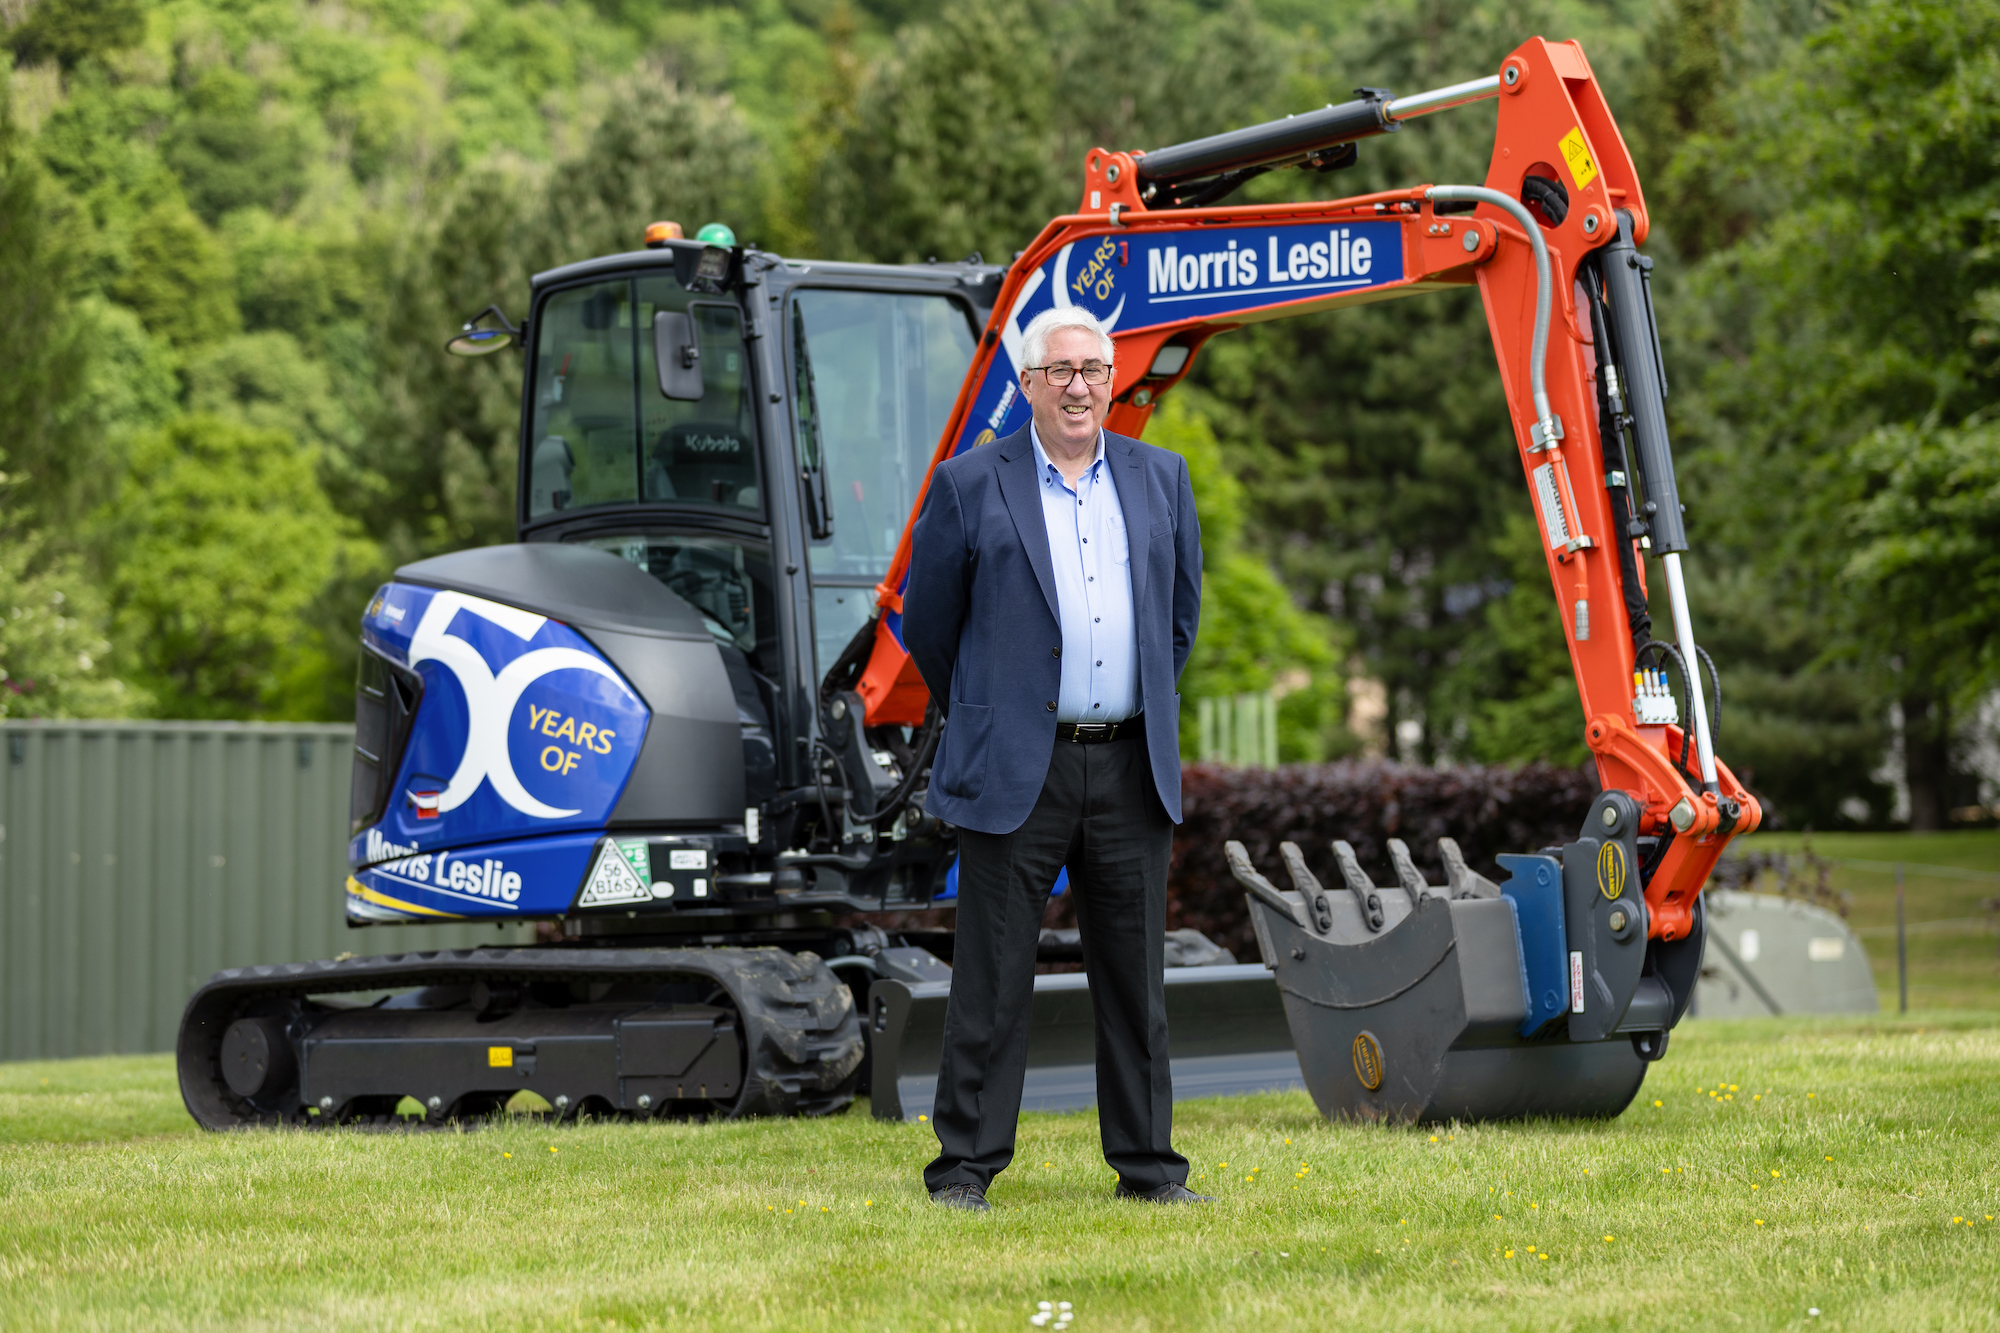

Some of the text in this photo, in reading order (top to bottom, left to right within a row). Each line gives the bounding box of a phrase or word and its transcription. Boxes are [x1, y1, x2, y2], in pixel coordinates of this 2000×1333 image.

[1071, 235, 1116, 296] YEARS
[1095, 268, 1115, 301] OF
[1148, 228, 1372, 294] Morris Leslie
[529, 703, 616, 755] YEARS
[540, 745, 582, 776] OF
[367, 828, 523, 902] Morris Leslie
[603, 863, 622, 878] 56
